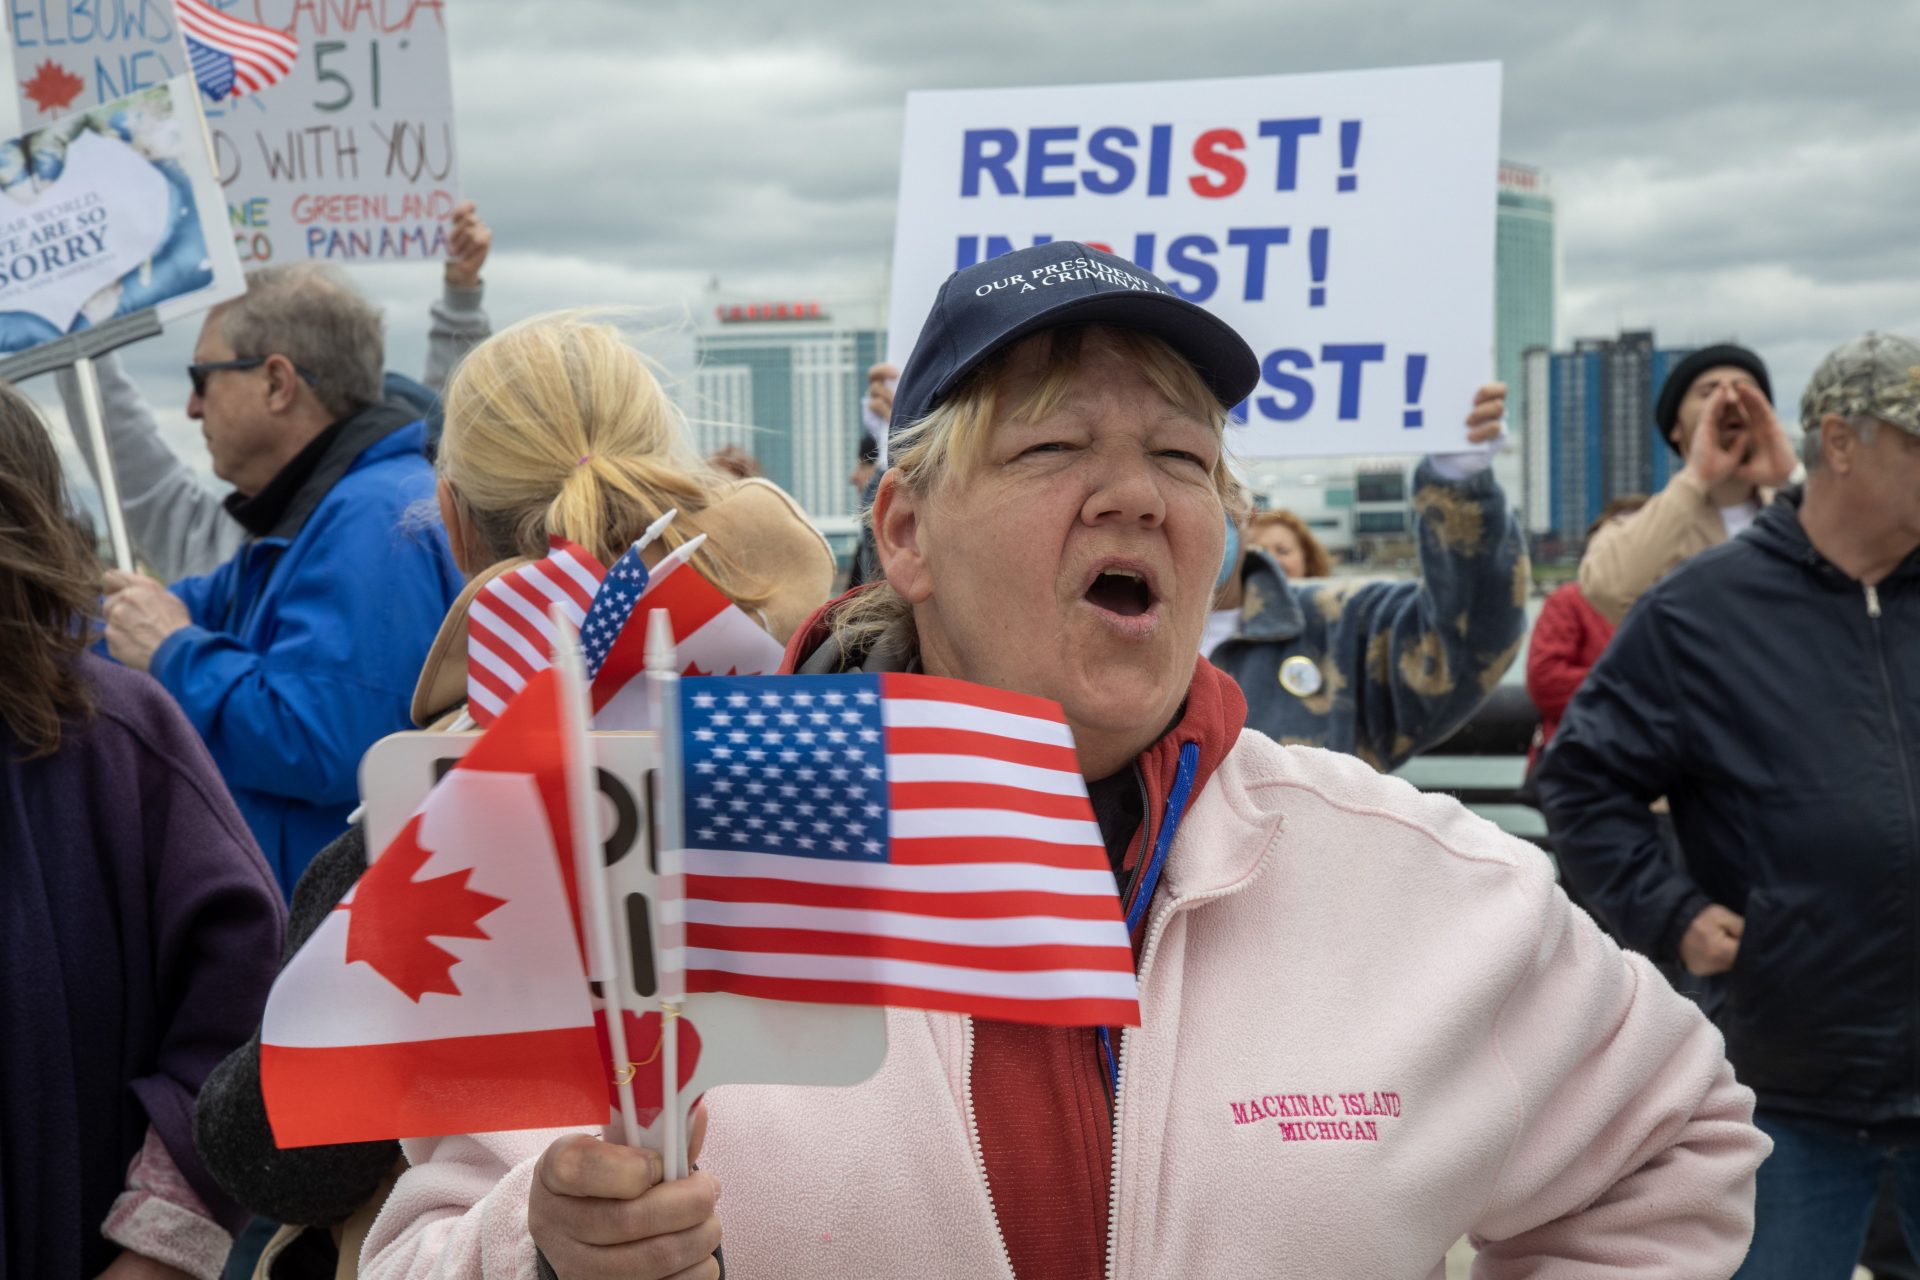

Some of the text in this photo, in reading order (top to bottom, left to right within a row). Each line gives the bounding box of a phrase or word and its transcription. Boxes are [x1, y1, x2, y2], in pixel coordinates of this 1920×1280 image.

[256, 125, 358, 181] WITH
[371, 121, 452, 182] YOU
[291, 190, 454, 224] GREENLAND
[29, 219, 72, 247] ARE
[77, 206, 106, 226] SO
[306, 225, 450, 258] PANAMA
[975, 274, 1026, 297] OUR
[1031, 257, 1150, 289] PRESIDENT
[1020, 267, 1149, 294] A CRIMINA
[1230, 1091, 1402, 1125] MACKINAC ISLAND
[1278, 1120, 1378, 1142] MICHIGAN
